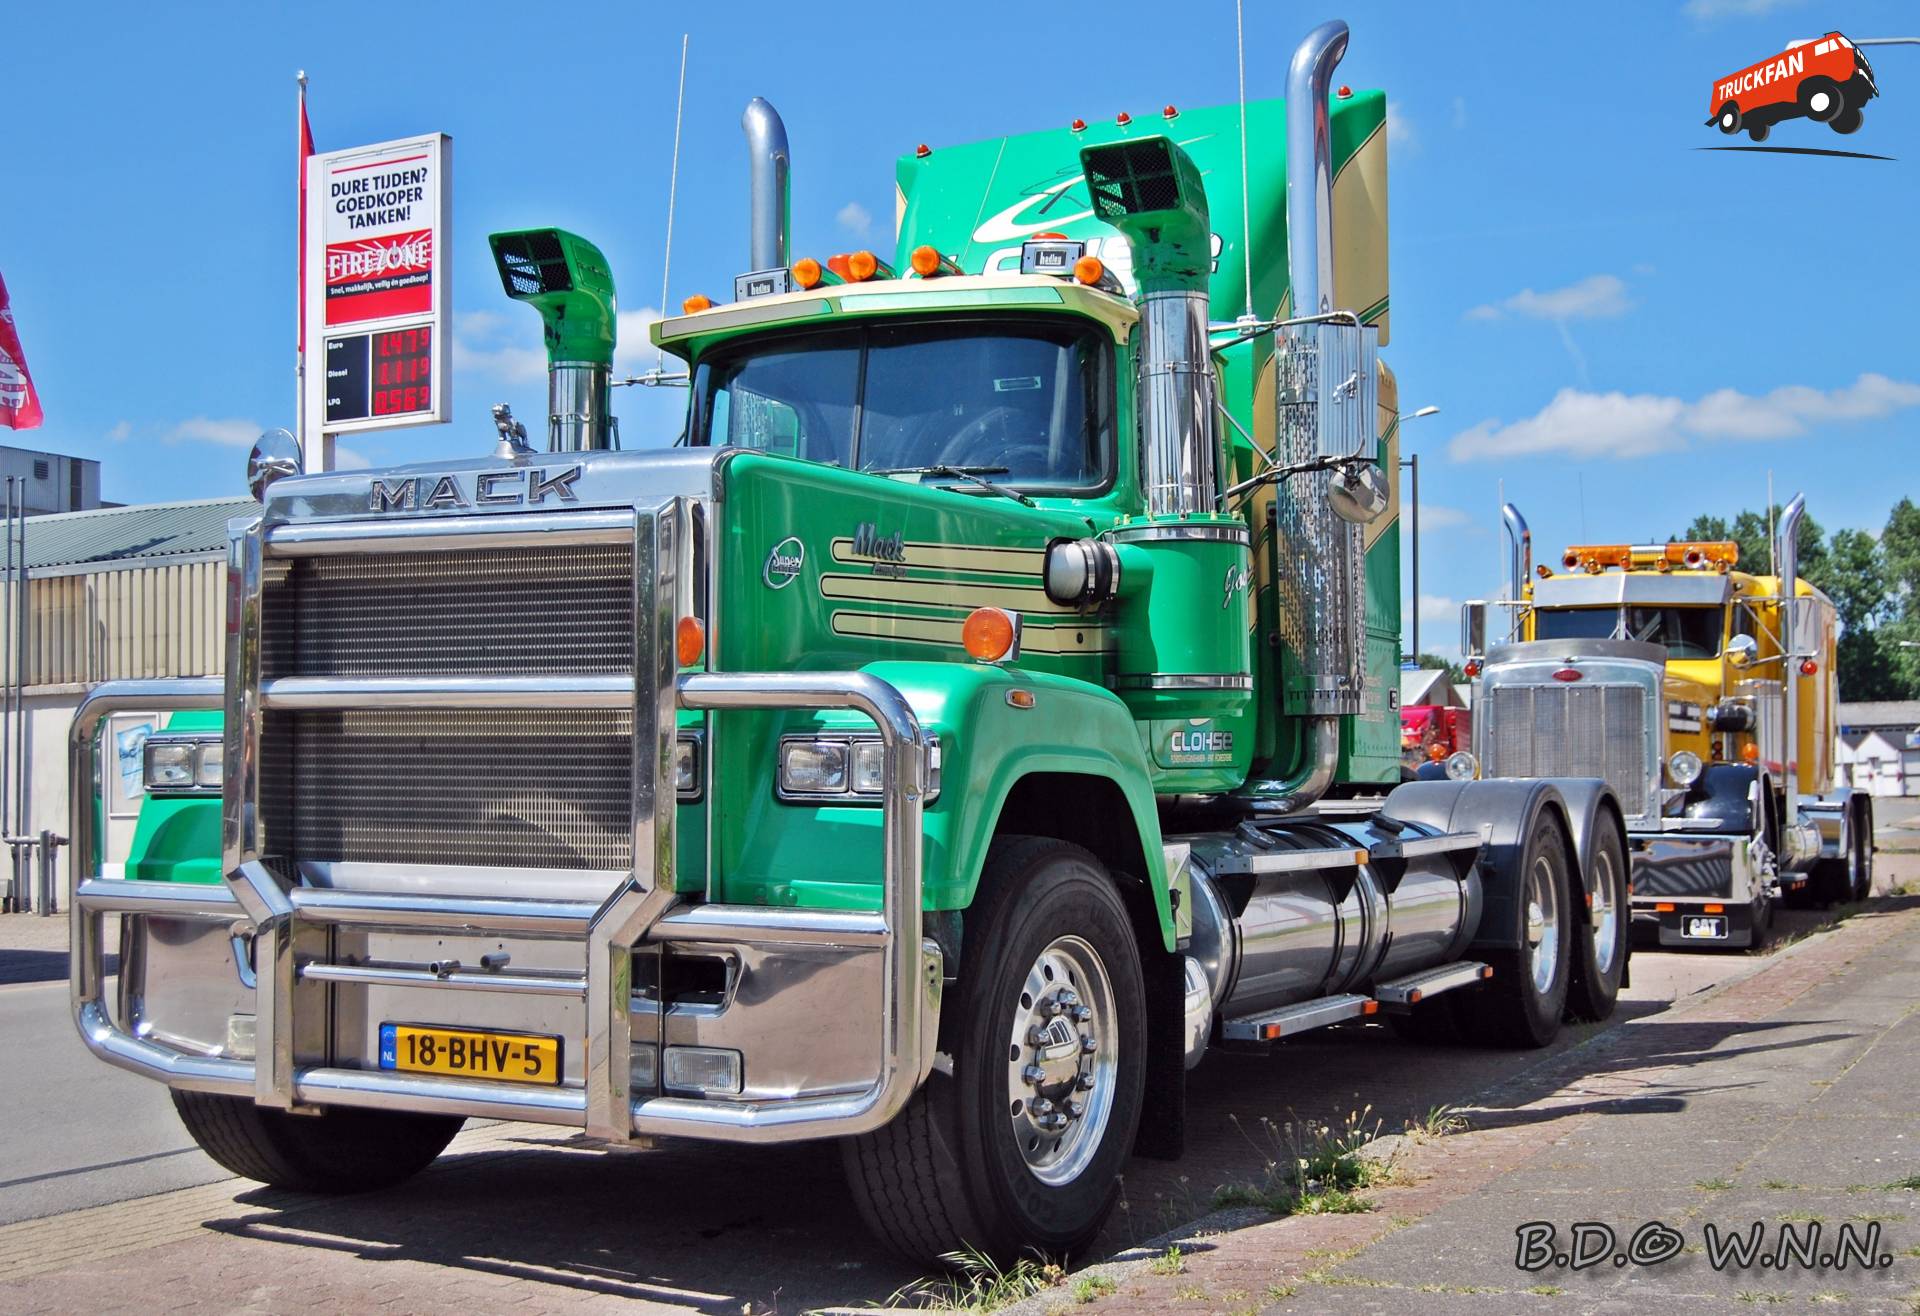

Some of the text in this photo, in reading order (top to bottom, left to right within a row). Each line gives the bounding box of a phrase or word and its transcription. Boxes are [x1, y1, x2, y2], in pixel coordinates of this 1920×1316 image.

[331, 167, 428, 197] DURE TIJDEN?
[336, 186, 423, 214] GOEDKOPER
[348, 206, 411, 230] TANKEN!
[329, 241, 428, 278] FIREZONE
[1039, 252, 1061, 266] hadley
[328, 342, 343, 350] Euro
[328, 368, 348, 378] Diesel
[369, 464, 584, 513] MACK
[852, 521, 906, 562] Mack
[1690, 918, 1720, 937] CAT
[383, 1033, 542, 1076] NL 18-BHV-5
